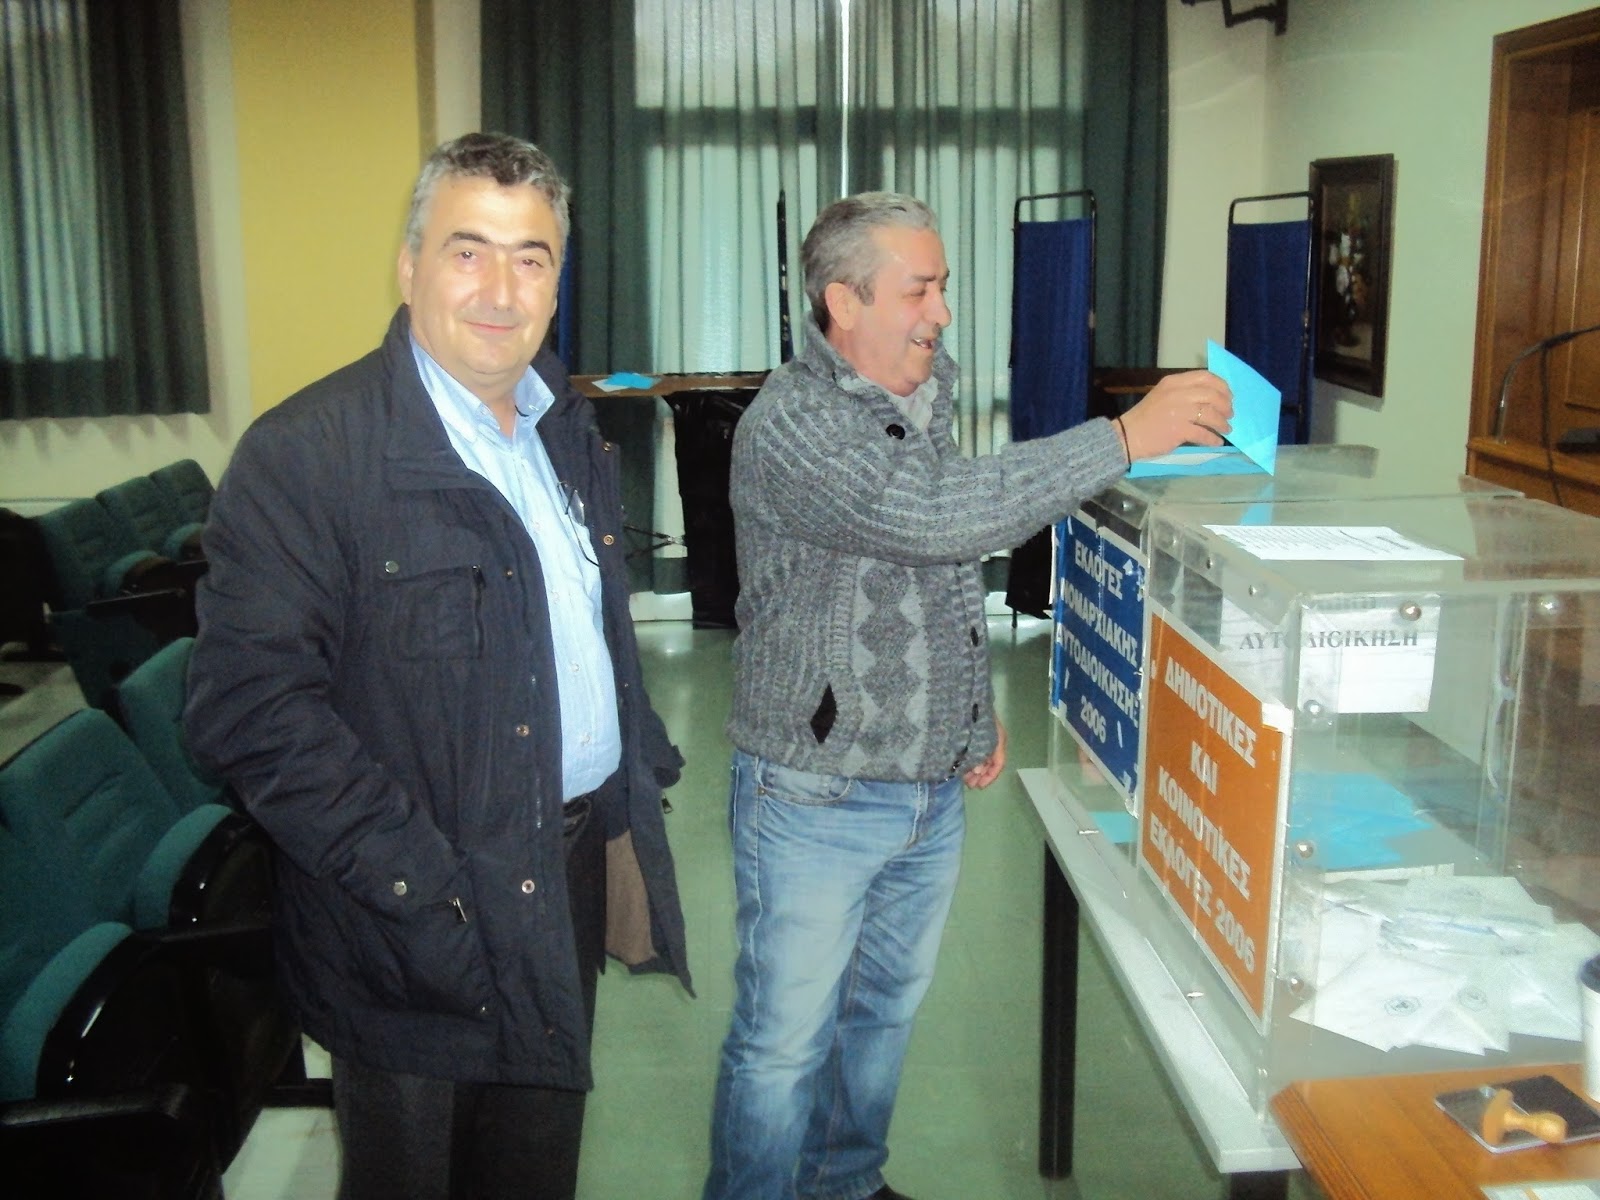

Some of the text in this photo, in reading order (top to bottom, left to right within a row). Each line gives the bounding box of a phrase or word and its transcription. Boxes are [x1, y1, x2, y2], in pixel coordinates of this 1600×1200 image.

[1074, 540, 1123, 600] ΕΚΛΟΓΕΣ
[1060, 577, 1138, 666] ΝΟΜΑΡΧΙΑΚΗΣ
[1080, 695, 1107, 744] 2006
[1165, 656, 1258, 768] ΔΗΜΟΤΙΚΕΣ
[1190, 740, 1219, 796] ΚΑΙ
[1158, 766, 1251, 901] ΚΟΙΝΟΤΙΚΕΣ
[1149, 811, 1256, 974] ΕΚΛΟΓΕΣ 2006
